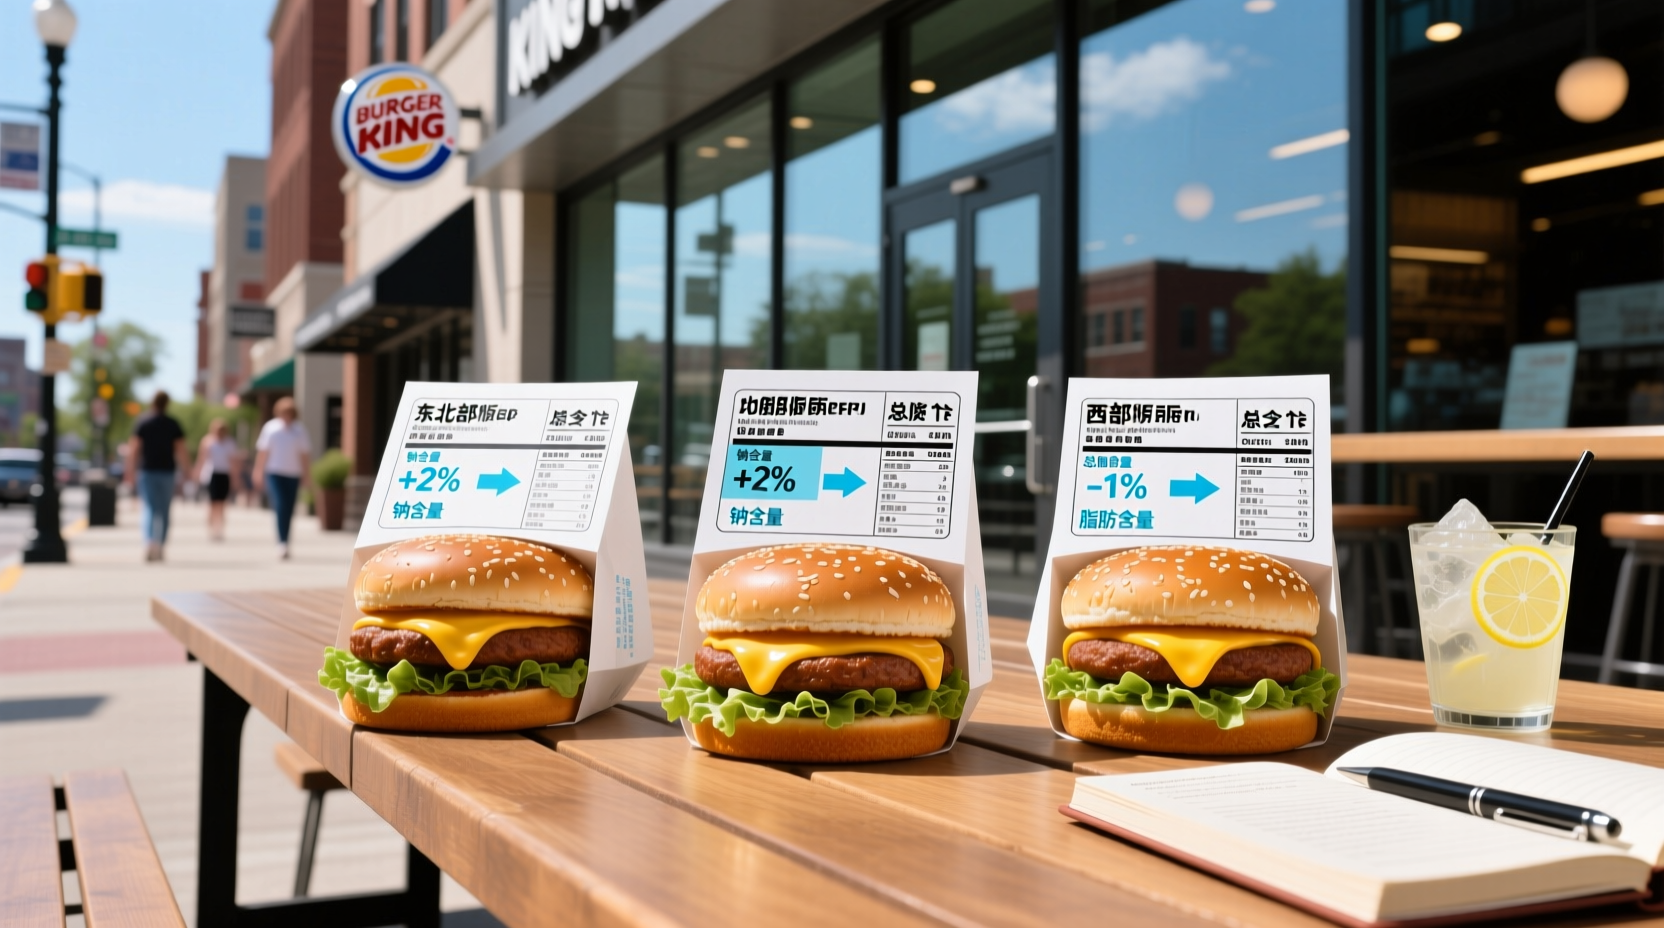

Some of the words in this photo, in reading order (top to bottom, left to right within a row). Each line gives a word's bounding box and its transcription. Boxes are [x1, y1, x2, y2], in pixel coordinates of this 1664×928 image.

[356, 93, 442, 125] BURGER
[358, 113, 445, 155] KING
[398, 467, 460, 492] +2%
[733, 466, 796, 492] +2%
[729, 506, 784, 526] 钠含量
[1079, 508, 1154, 529] 脂肪含量
